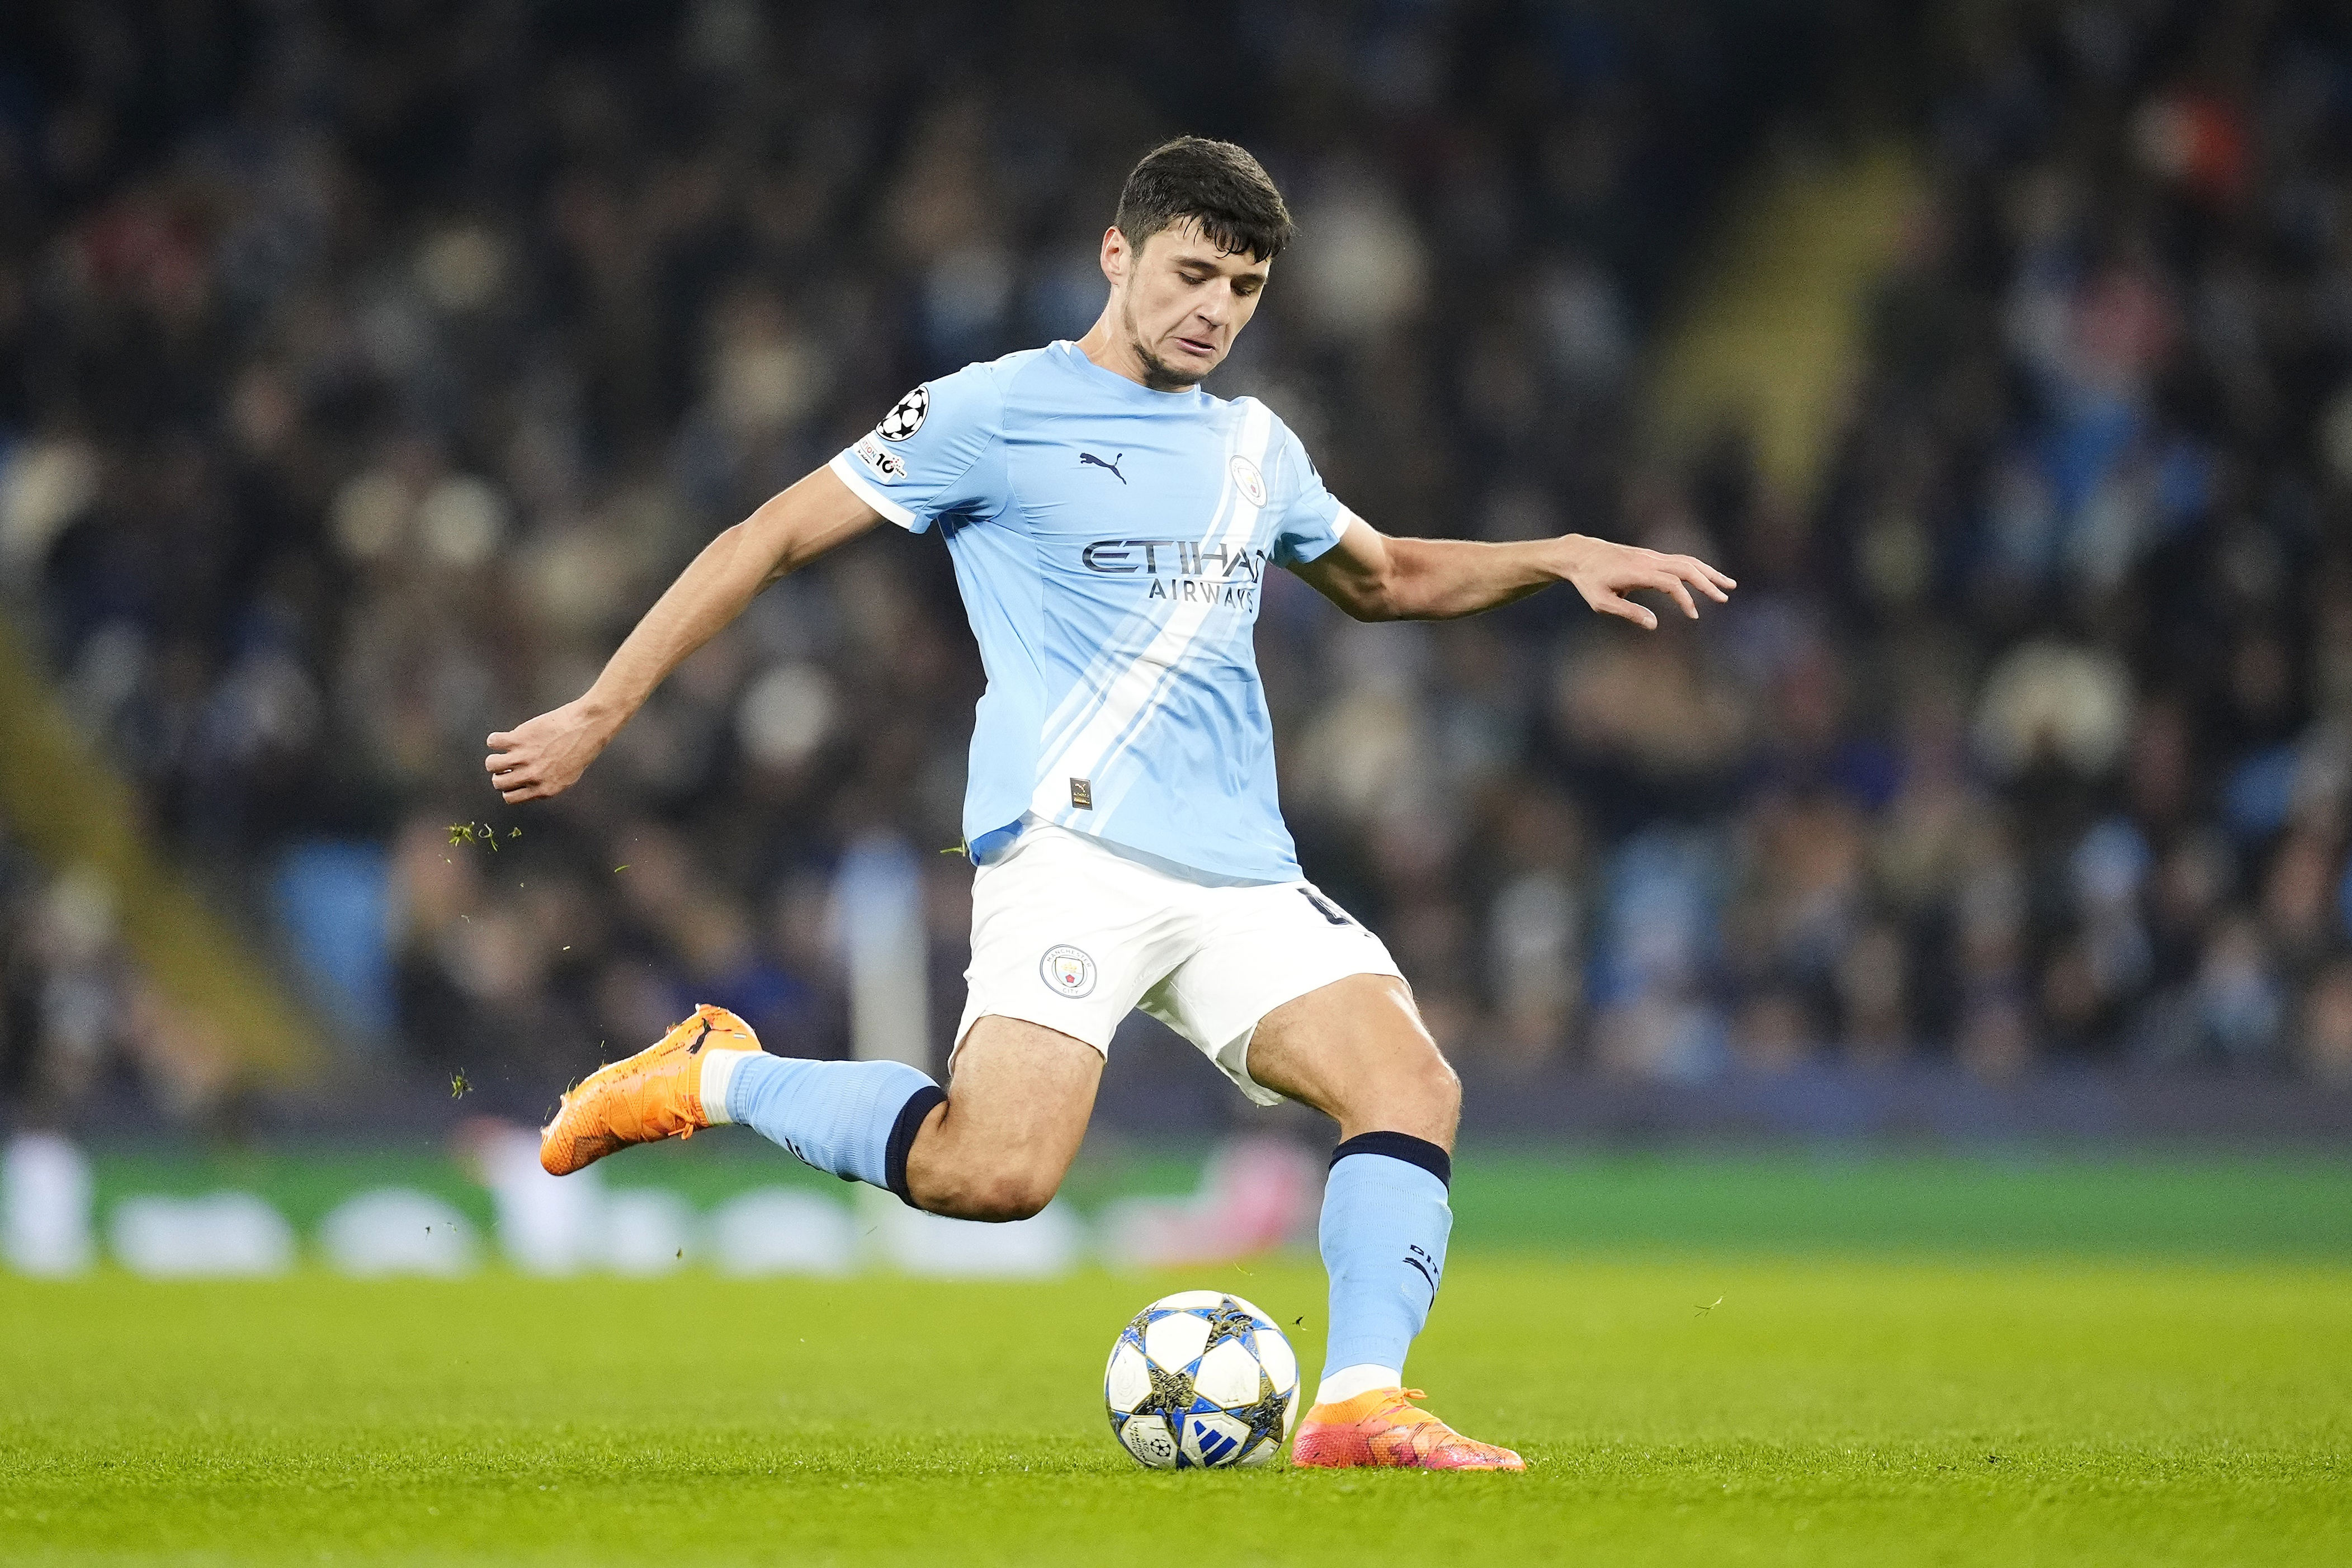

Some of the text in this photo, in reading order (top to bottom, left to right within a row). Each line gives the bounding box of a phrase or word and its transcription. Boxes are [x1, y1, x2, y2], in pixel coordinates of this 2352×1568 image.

[876, 453, 895, 474] 10
[1149, 578, 1253, 613] AIRWAYS
[1047, 949, 1091, 967] MANCHESTER
